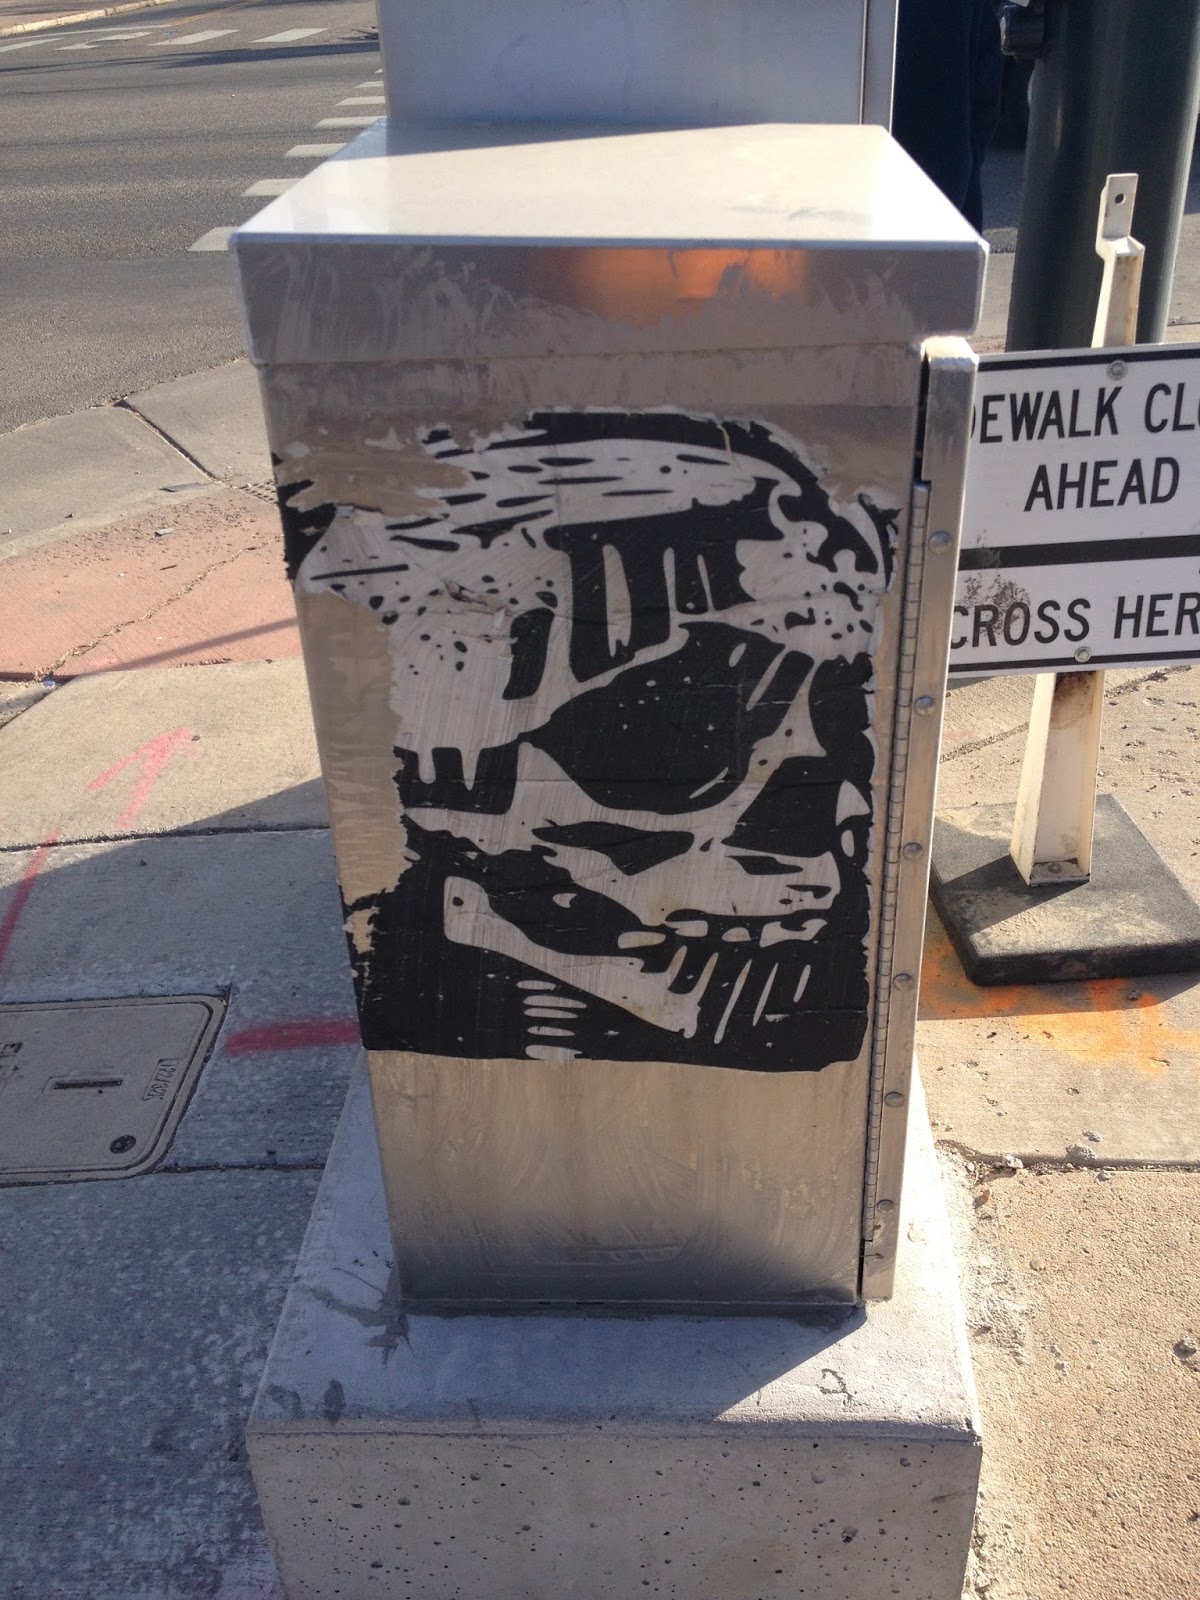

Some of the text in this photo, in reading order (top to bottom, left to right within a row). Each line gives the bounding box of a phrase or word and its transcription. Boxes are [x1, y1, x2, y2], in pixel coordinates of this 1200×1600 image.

[970, 383, 1200, 444] EWALK CL
[1024, 457, 1180, 512] AHEAD
[950, 592, 1200, 649] CROSS HER
